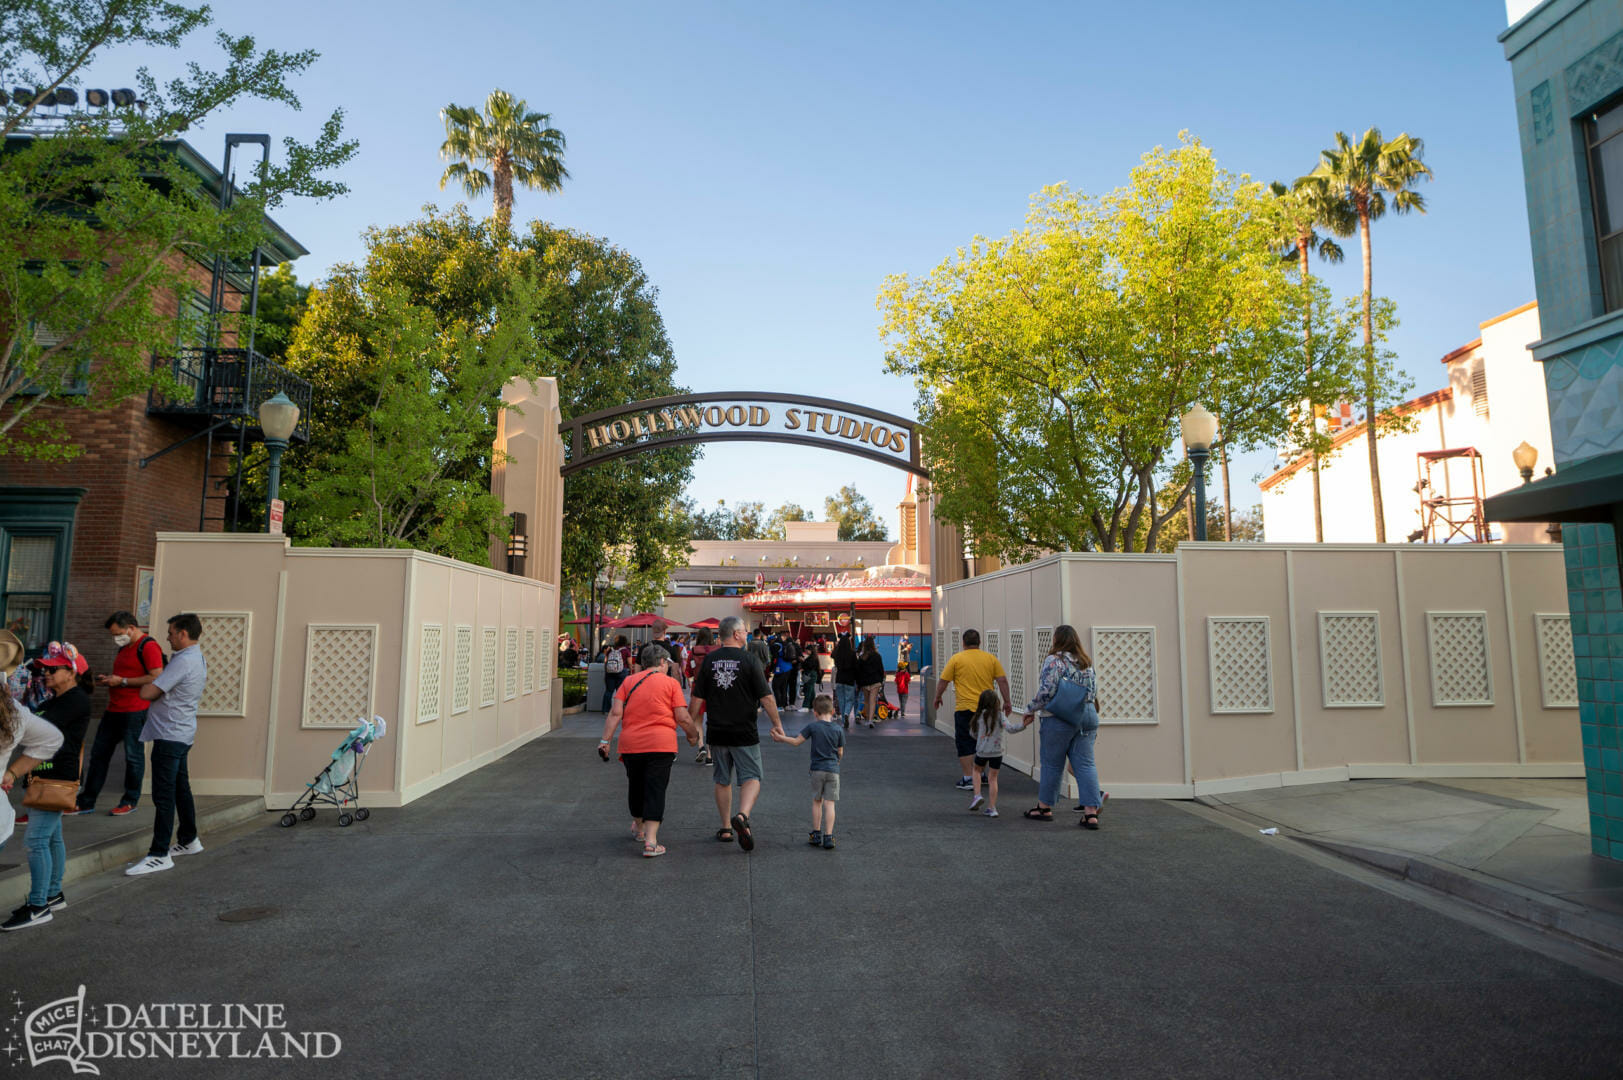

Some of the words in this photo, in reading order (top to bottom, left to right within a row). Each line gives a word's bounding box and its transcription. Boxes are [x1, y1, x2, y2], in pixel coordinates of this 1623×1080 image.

[588, 405, 770, 449] HOLLYWOOD
[785, 408, 908, 453] STUDIOS
[795, 573, 822, 589] Cold
